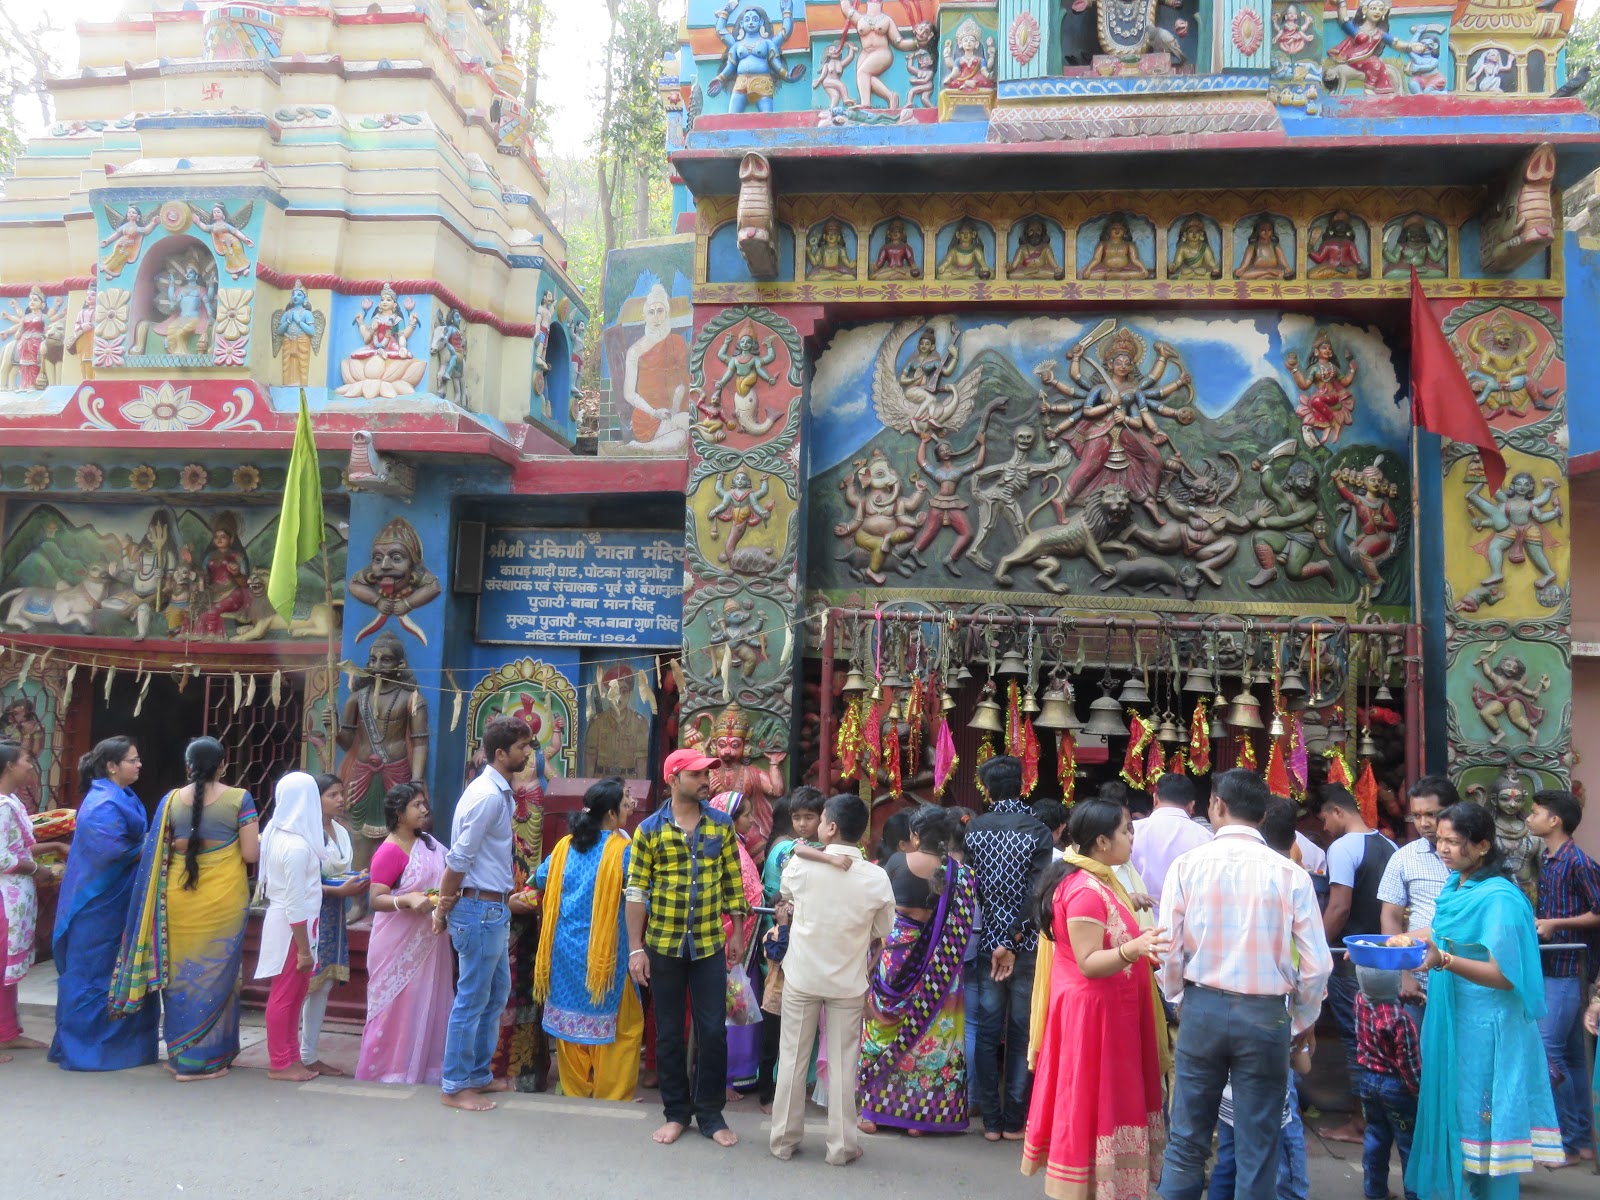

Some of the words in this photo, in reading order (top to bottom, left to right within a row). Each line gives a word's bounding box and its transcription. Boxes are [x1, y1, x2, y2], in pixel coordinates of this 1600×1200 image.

[528, 538, 587, 559] रंकिणी
[594, 545, 636, 561] माता
[641, 540, 685, 563] मंदिर
[534, 578, 551, 591] एवं
[553, 578, 597, 593] संचालक
[625, 581, 637, 594] से
[603, 599, 630, 611] मान
[631, 596, 656, 613] सिंह
[506, 614, 537, 629] मुख्य
[539, 612, 577, 630] पुजारी
[634, 618, 656, 632] गुण
[656, 614, 680, 631] सिंह
[525, 629, 556, 641] मंदिर
[558, 630, 592, 642] निर्माण
[600, 634, 637, 642] 1964
